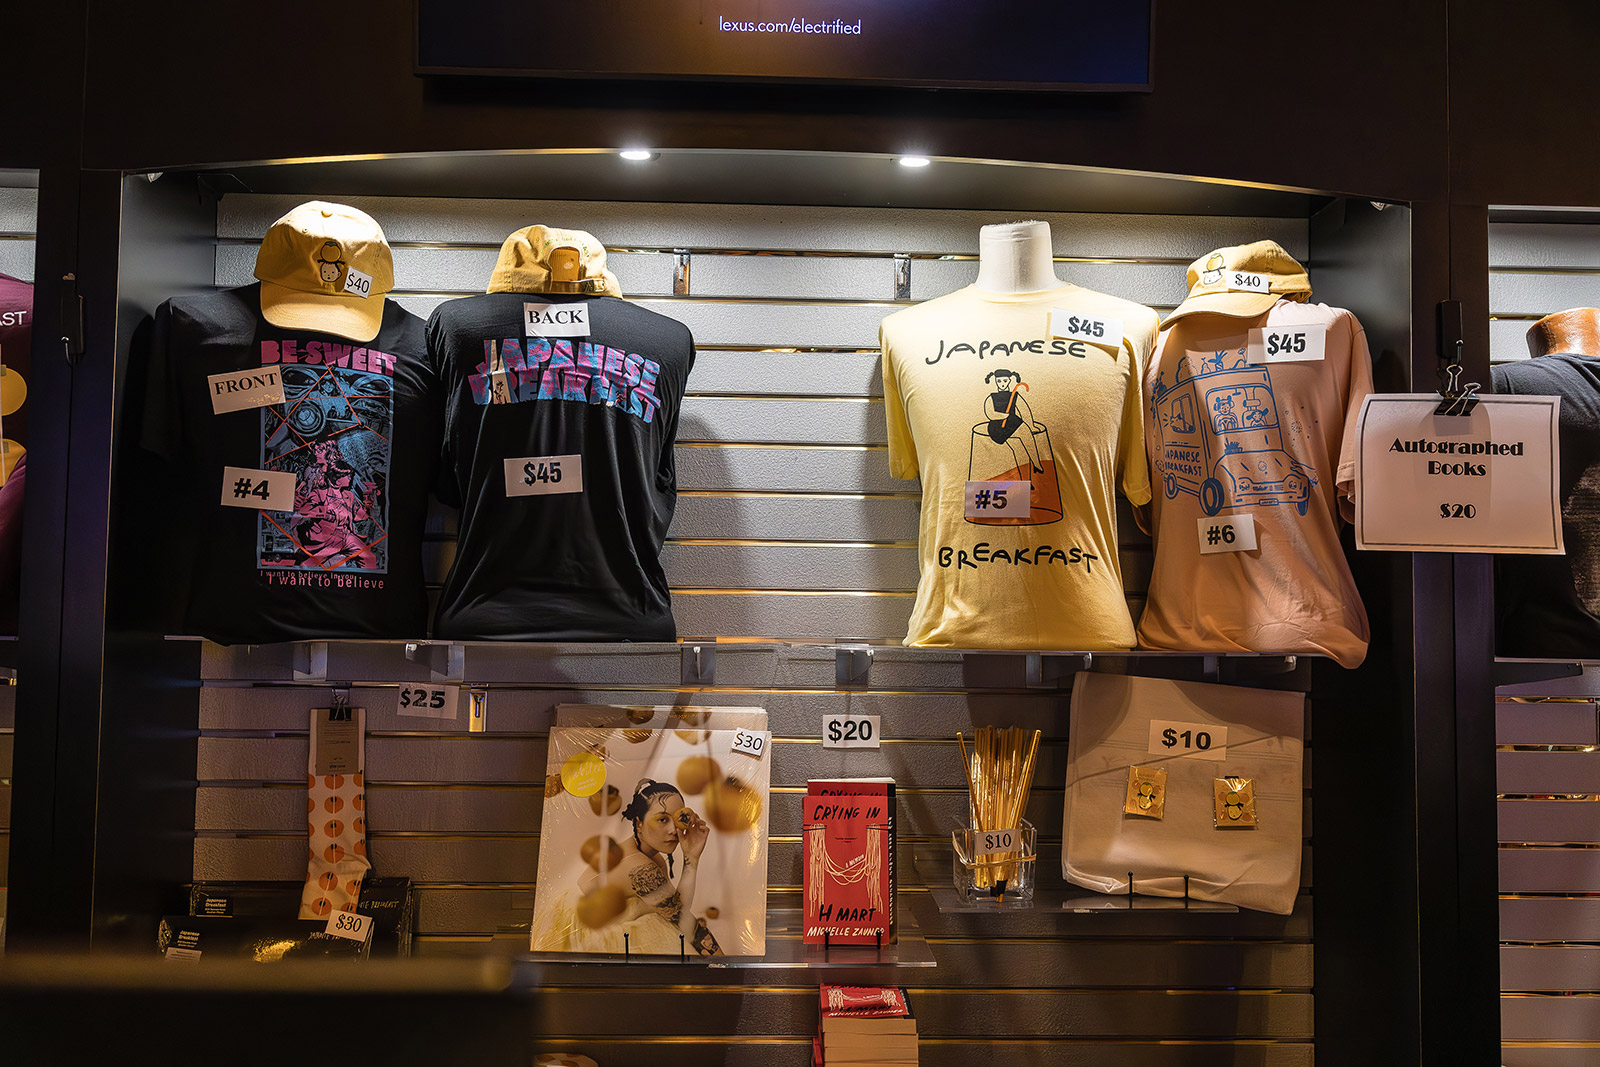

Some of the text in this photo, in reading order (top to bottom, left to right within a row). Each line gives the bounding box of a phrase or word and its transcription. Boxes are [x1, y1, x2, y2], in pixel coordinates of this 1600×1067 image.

[718, 16, 861, 35] lexus.com/electrified
[346, 272, 370, 294] $40
[1234, 274, 1261, 288] $40
[0, 311, 27, 326] ST
[528, 310, 583, 325] BACK
[1068, 316, 1104, 337] $45
[925, 340, 1086, 365] JAPANESE
[1267, 332, 1306, 356] $45
[214, 373, 277, 395] FRONT
[1389, 438, 1524, 456] Autographed
[523, 461, 562, 486] $45
[1428, 461, 1486, 476] Books
[233, 478, 270, 501] #4
[975, 490, 1007, 510] #5
[1440, 504, 1476, 519] $20
[1207, 525, 1236, 545] #6
[938, 542, 1098, 573] BREAKFAST
[280, 575, 312, 587] want
[318, 577, 331, 588] to
[338, 575, 384, 589] believe
[400, 688, 446, 709] $25
[734, 731, 763, 751] $30
[828, 719, 873, 744] $20
[1162, 728, 1212, 751] $10
[814, 805, 881, 820] CRYING IN
[985, 833, 1012, 850] $10
[335, 913, 362, 933] $30
[819, 904, 876, 922] H MART
